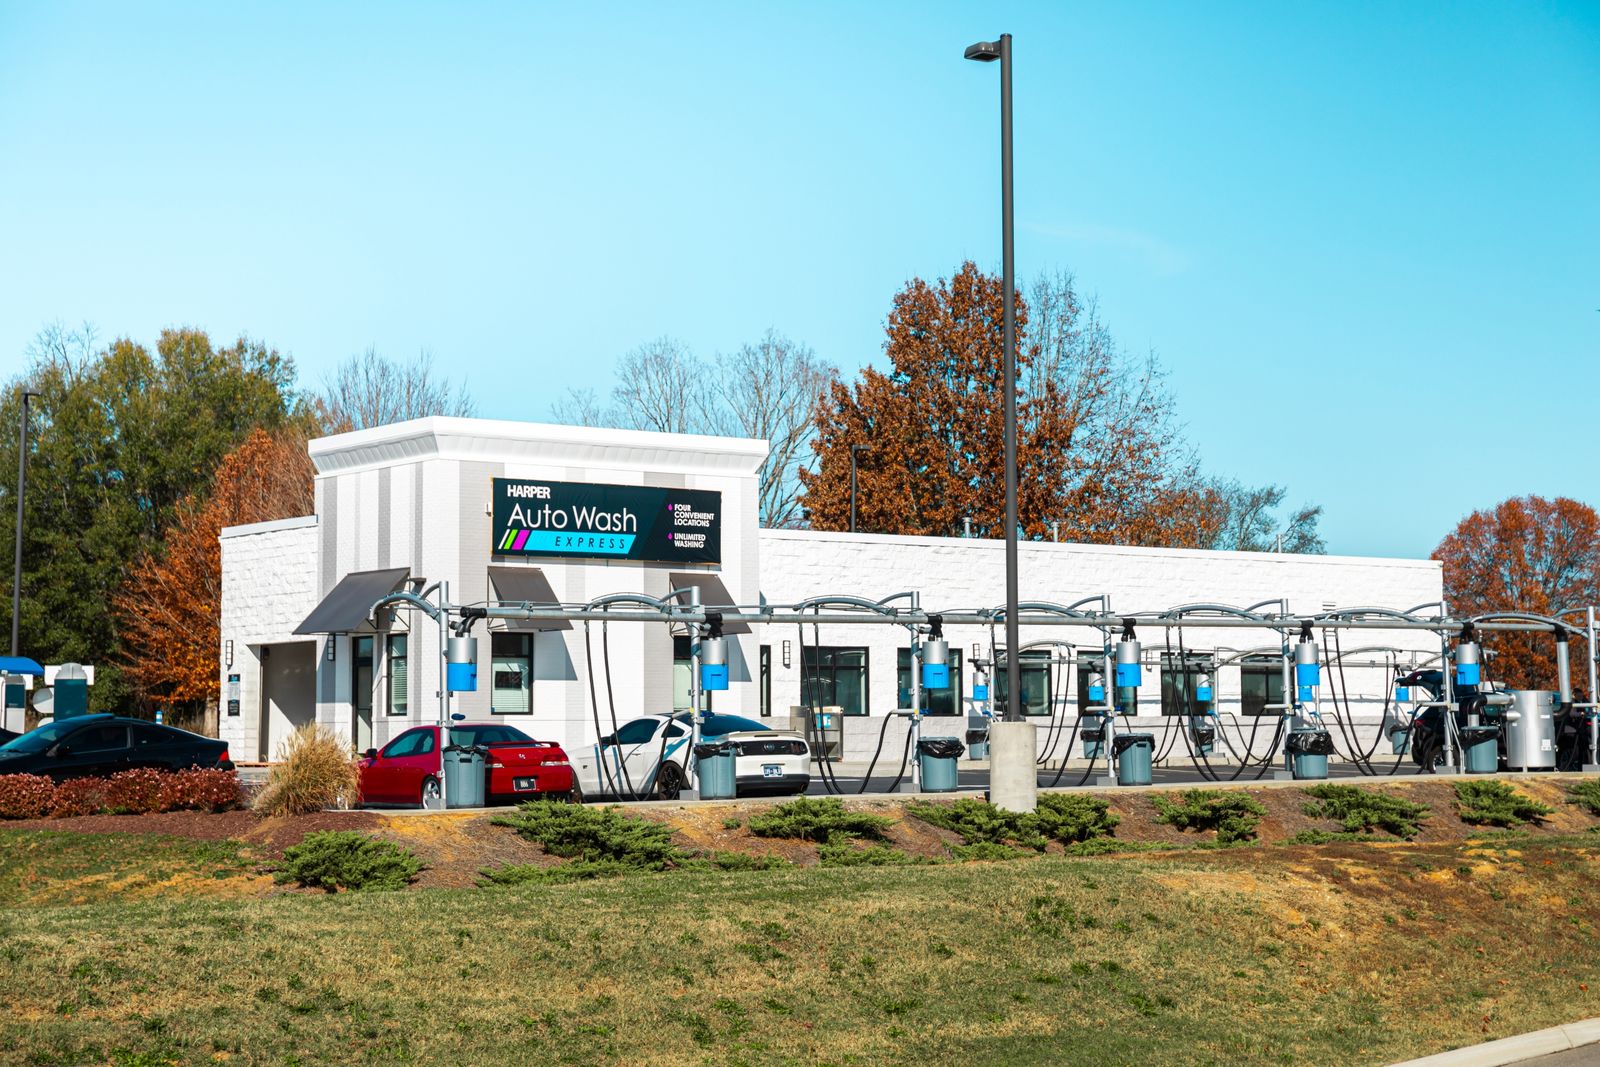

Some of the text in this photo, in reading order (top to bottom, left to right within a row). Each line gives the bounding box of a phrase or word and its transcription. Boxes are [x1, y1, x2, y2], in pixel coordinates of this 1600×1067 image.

[507, 484, 551, 499] HARPER
[507, 503, 637, 532] Auto Wash
[674, 511, 715, 520] CONVENIENT
[674, 519, 710, 527] LOCATIONS
[674, 533, 706, 541] UNLIMITED
[555, 536, 625, 549] EXPRESS
[674, 540, 705, 548] WASHING
